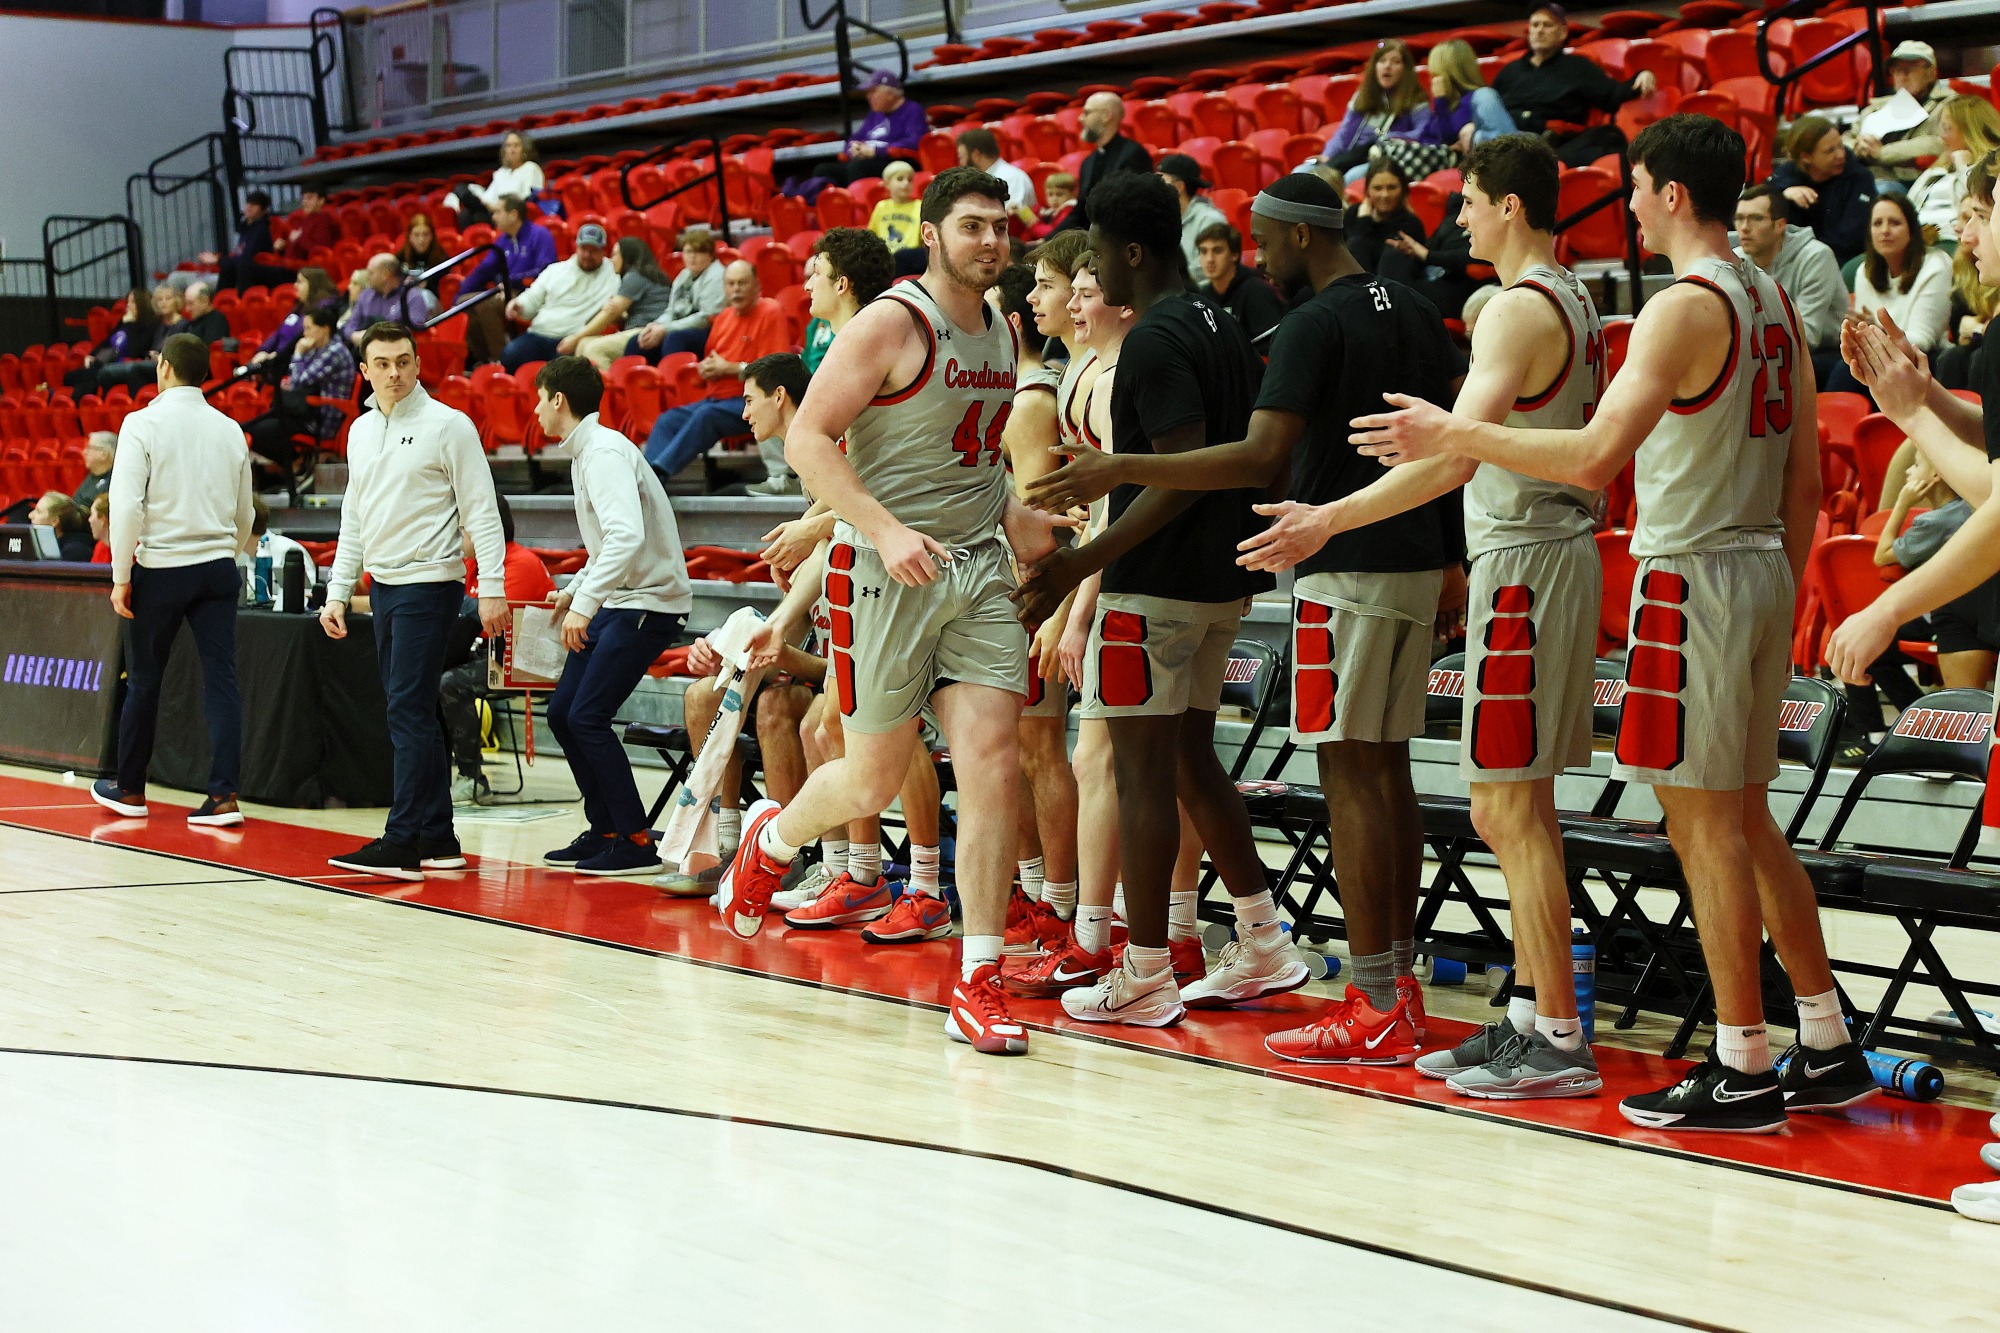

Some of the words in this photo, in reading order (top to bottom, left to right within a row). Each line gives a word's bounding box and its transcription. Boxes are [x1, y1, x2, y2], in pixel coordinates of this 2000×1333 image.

[1368, 286, 1392, 311] 24
[504, 622, 513, 675] CATHOL
[4, 654, 102, 691] BASKETBALL
[1224, 658, 1263, 683] OLIC
[1779, 700, 1825, 731] OLIC
[1893, 708, 1992, 743] CATHOLIC
